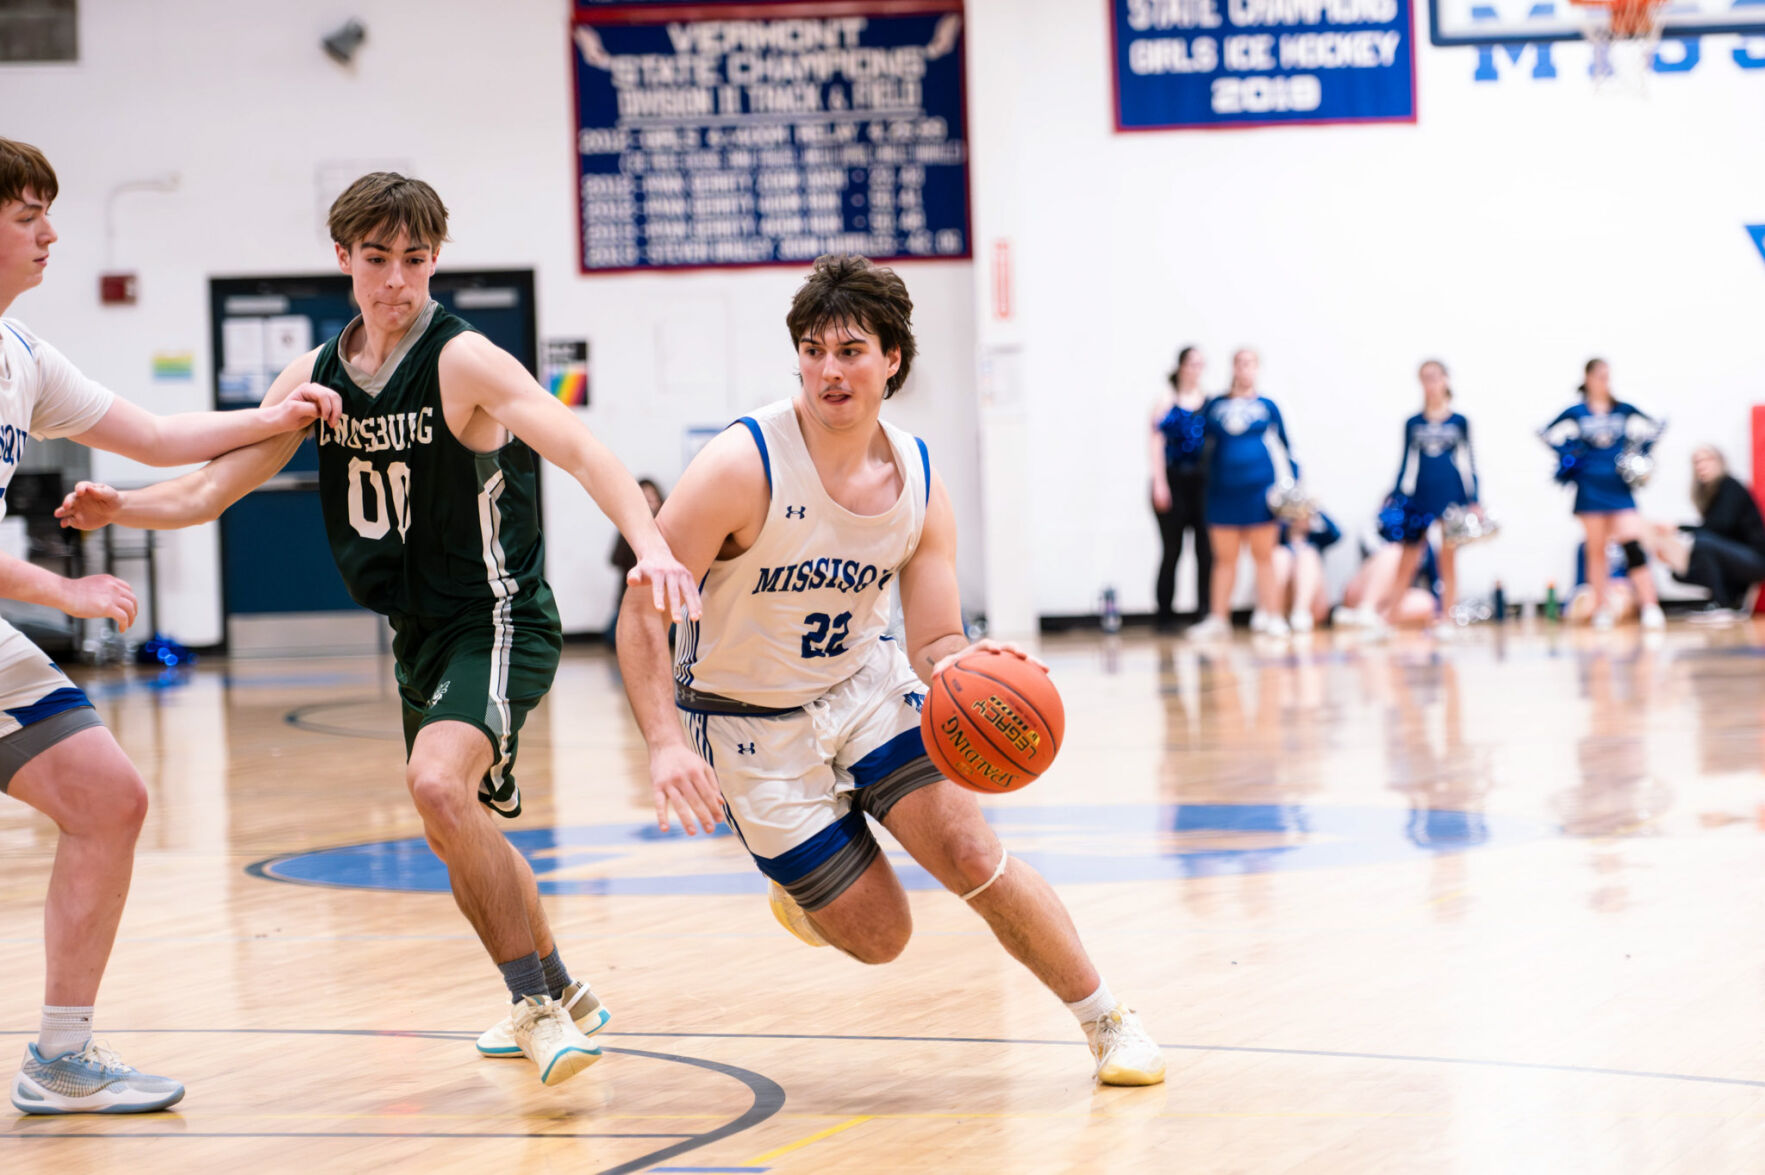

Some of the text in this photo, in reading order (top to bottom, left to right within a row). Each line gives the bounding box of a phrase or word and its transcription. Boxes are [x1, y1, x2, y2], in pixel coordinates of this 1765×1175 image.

[669, 19, 867, 54] VERMONT
[1129, 30, 1400, 75] GIRLS ICE HOCKEY
[612, 47, 925, 86] STATE CHAMPIONS
[751, 82, 820, 115] TRACK
[854, 77, 921, 111] FIELD
[348, 456, 411, 544] 00
[801, 611, 852, 659] 22
[941, 715, 1018, 787] SPALDING
[972, 700, 1037, 760] LEGACY
